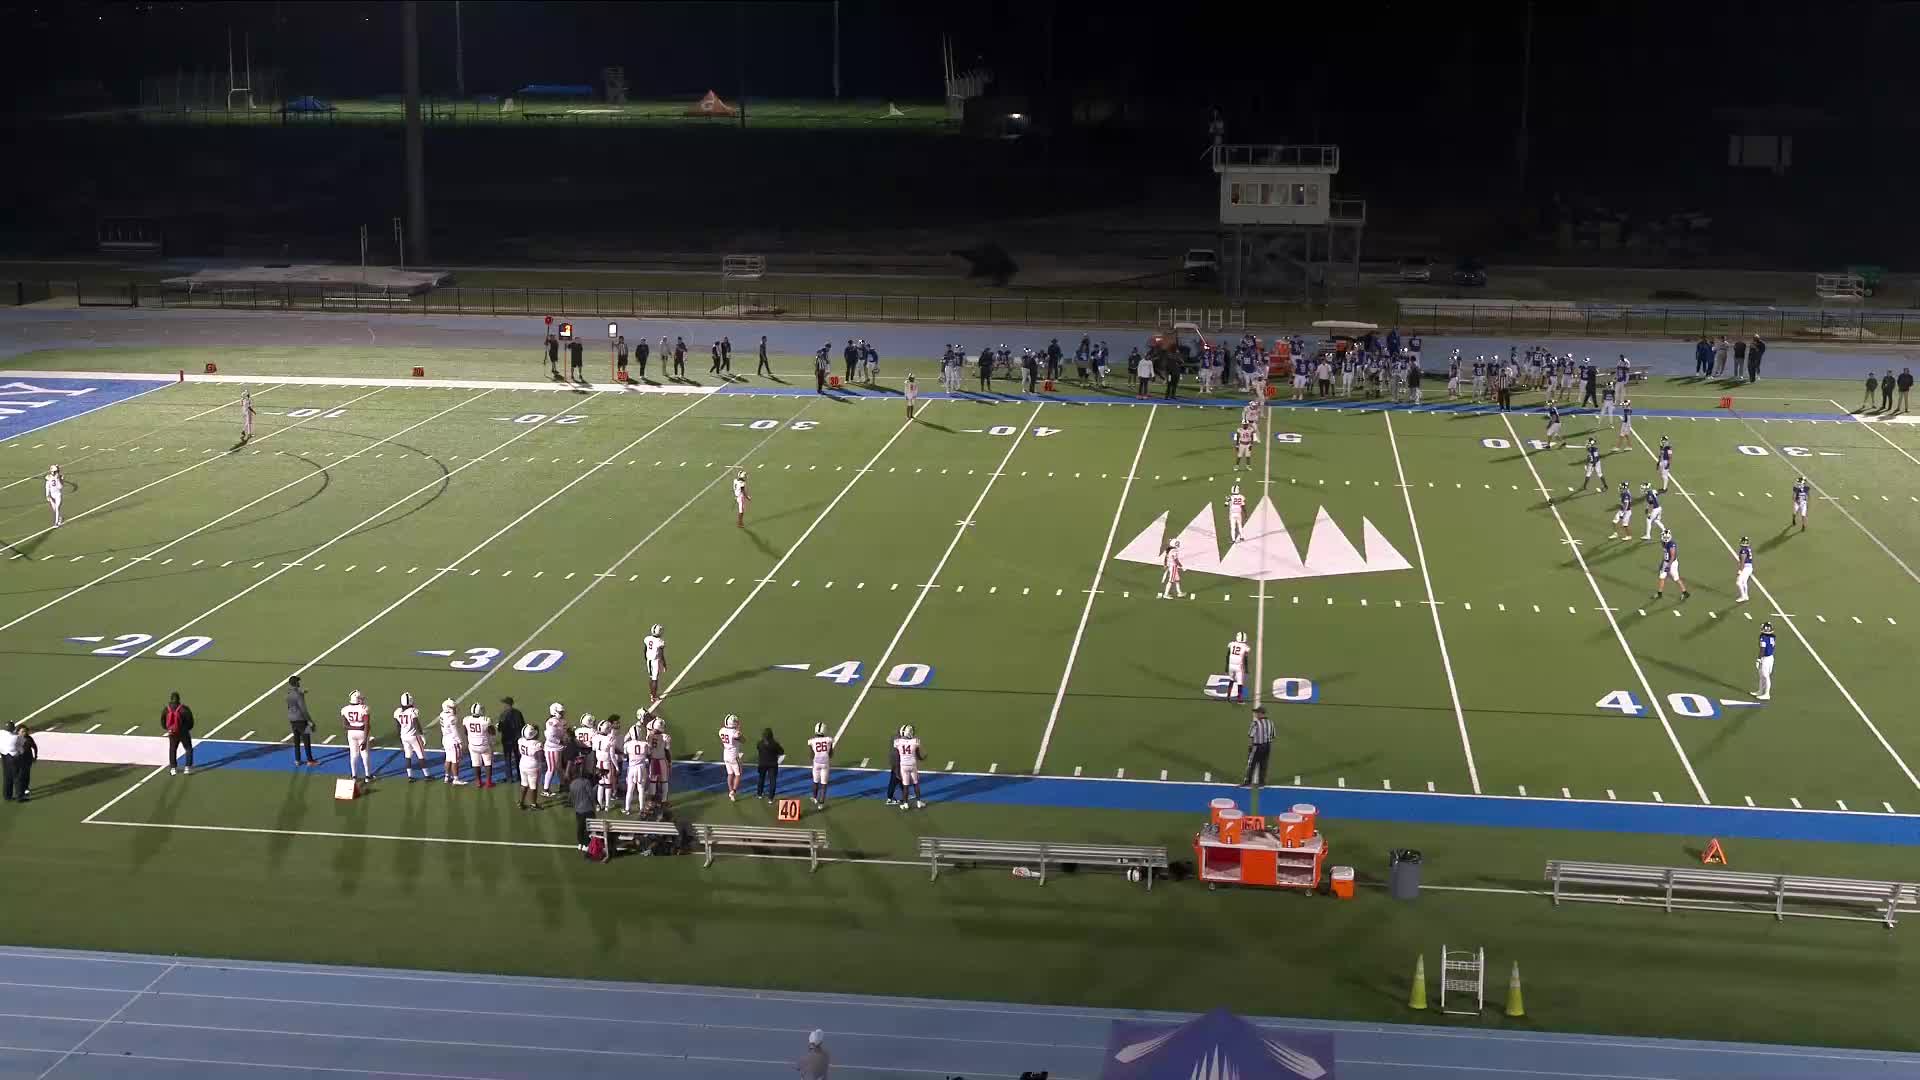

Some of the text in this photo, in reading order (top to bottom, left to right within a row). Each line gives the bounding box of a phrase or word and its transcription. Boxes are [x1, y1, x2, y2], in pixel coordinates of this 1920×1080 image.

[830, 376, 839, 386] 30
[748, 419, 820, 431] 30
[987, 426, 1063, 437] 40
[1736, 445, 1813, 457] 30
[1233, 497, 1243, 505] 22
[91, 633, 216, 658] 20
[1231, 645, 1242, 655] 12
[450, 647, 567, 673] 30
[815, 661, 935, 688] 40
[1595, 690, 1722, 720] 40
[347, 711, 359, 722] 57
[398, 714, 409, 725] 77
[469, 723, 482, 733] 50
[578, 732, 589, 742] 20
[520, 744, 529, 756] 51
[634, 744, 641, 755] 0
[815, 741, 828, 753] 26
[901, 745, 912, 755] 14
[780, 801, 798, 819] 40
